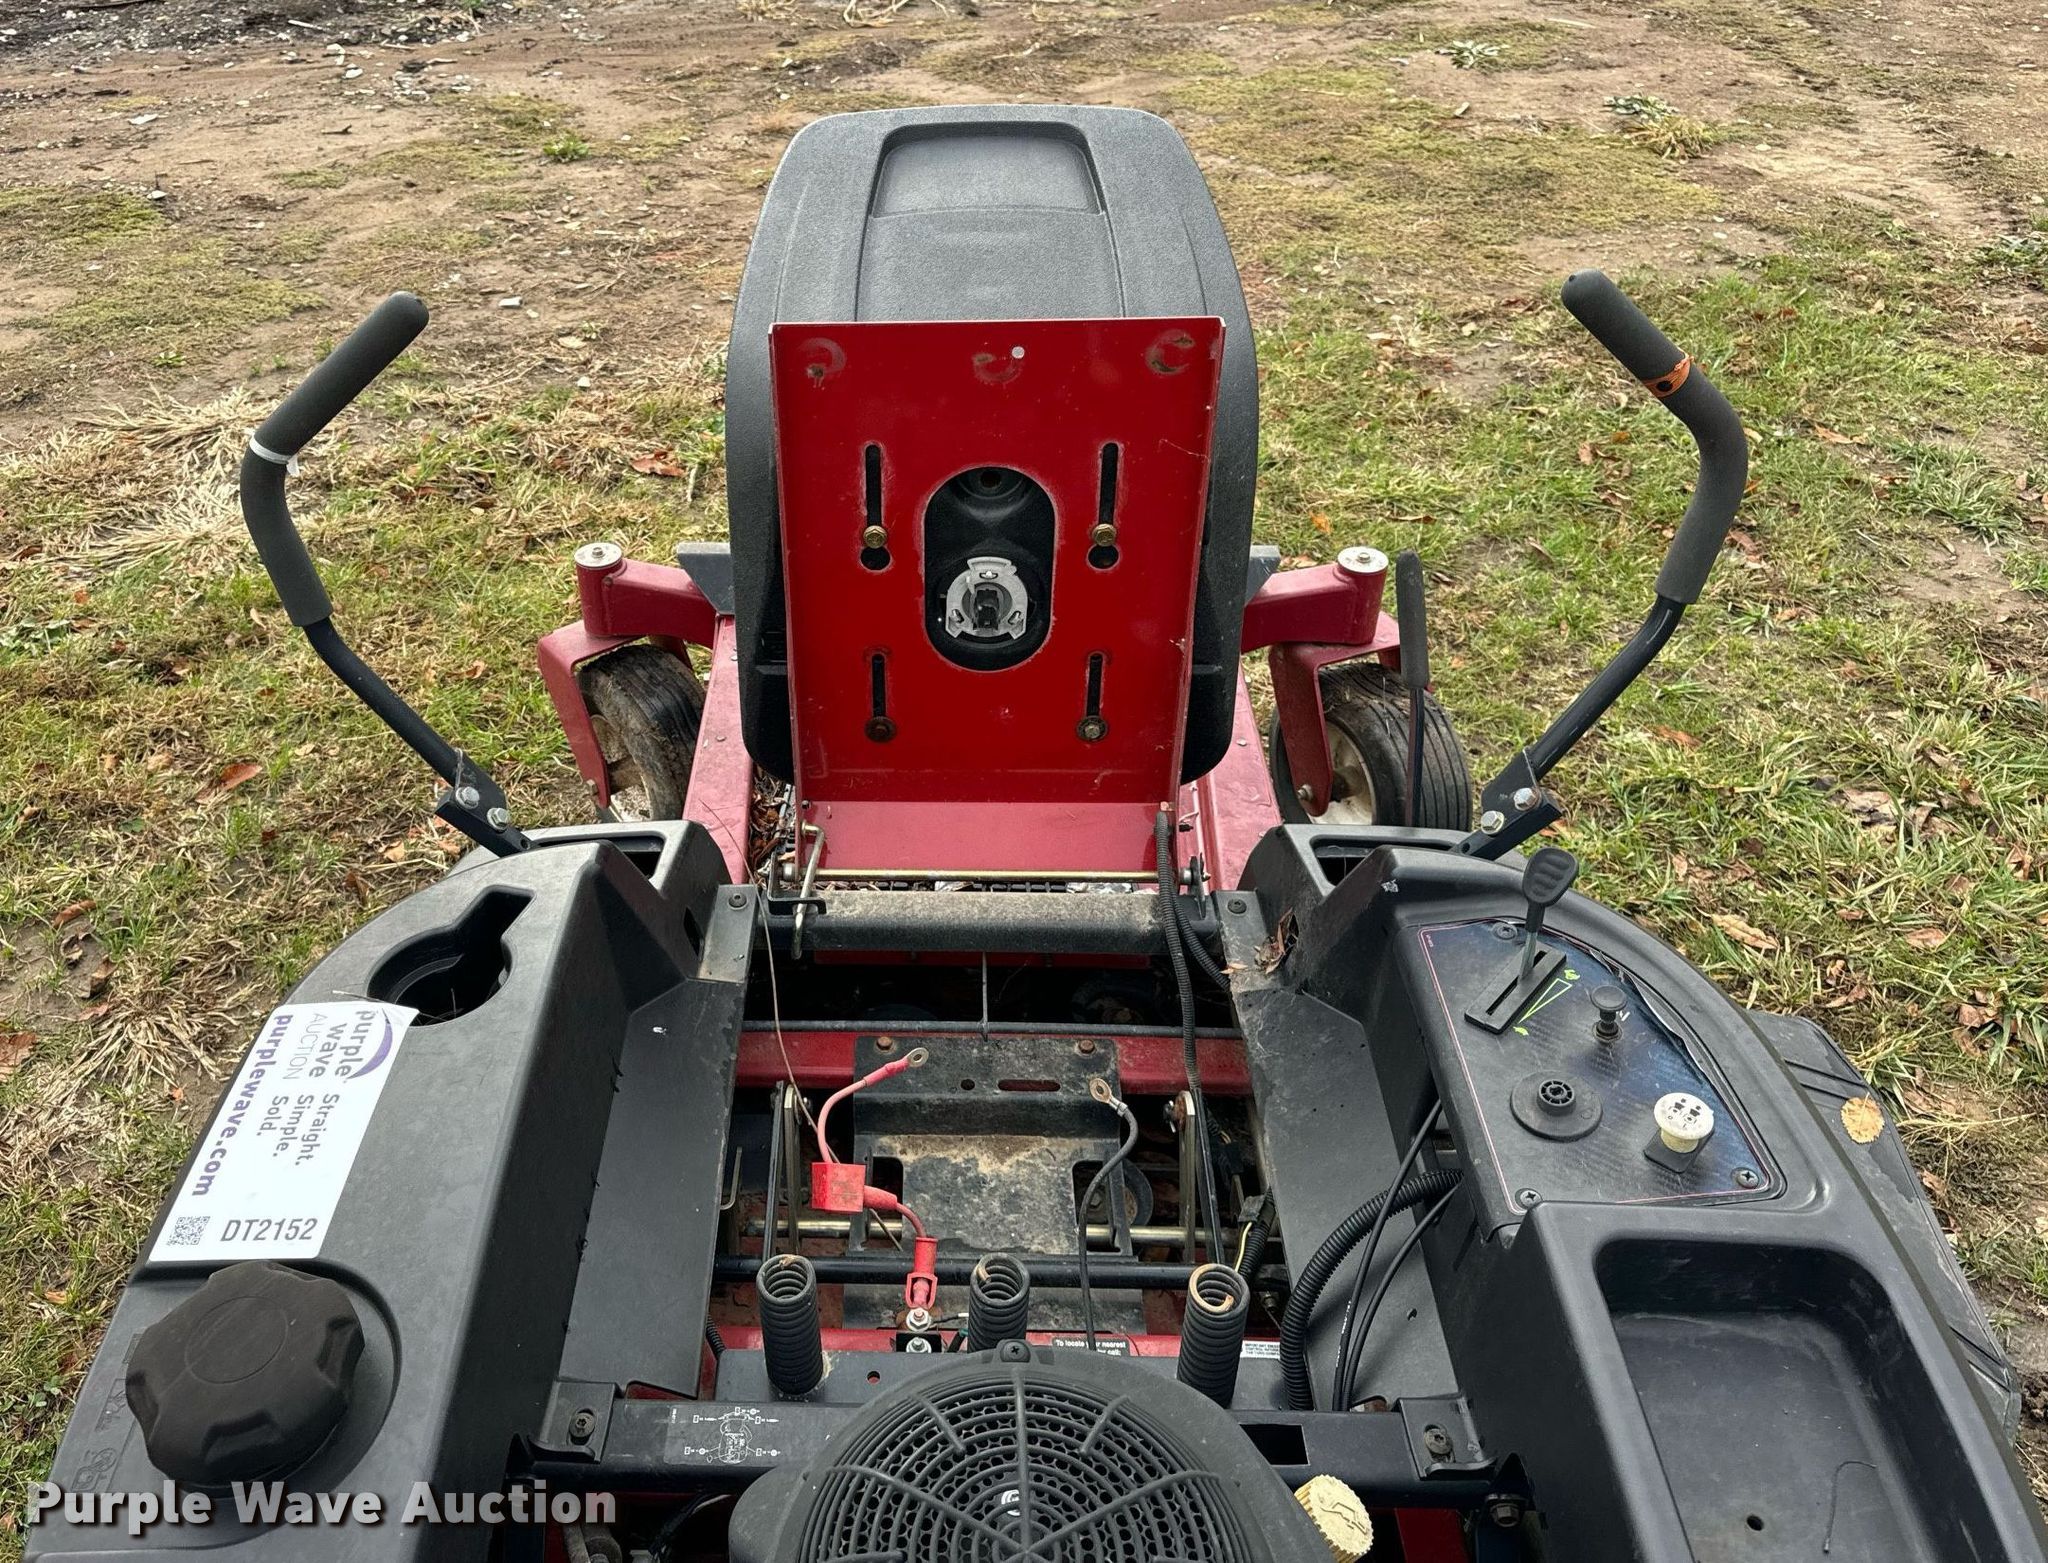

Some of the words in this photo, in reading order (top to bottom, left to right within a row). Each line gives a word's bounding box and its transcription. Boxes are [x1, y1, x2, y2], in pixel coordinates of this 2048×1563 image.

[282, 1013, 329, 1080] AUCTION
[308, 1023, 347, 1078] wave
[334, 1009, 375, 1078] purple
[191, 1014, 293, 1196] purplewave.com
[256, 1095, 289, 1136] Sold.
[272, 1094, 315, 1158] Simple.
[295, 1093, 340, 1166] Straight.
[220, 1218, 318, 1242] DT2152
